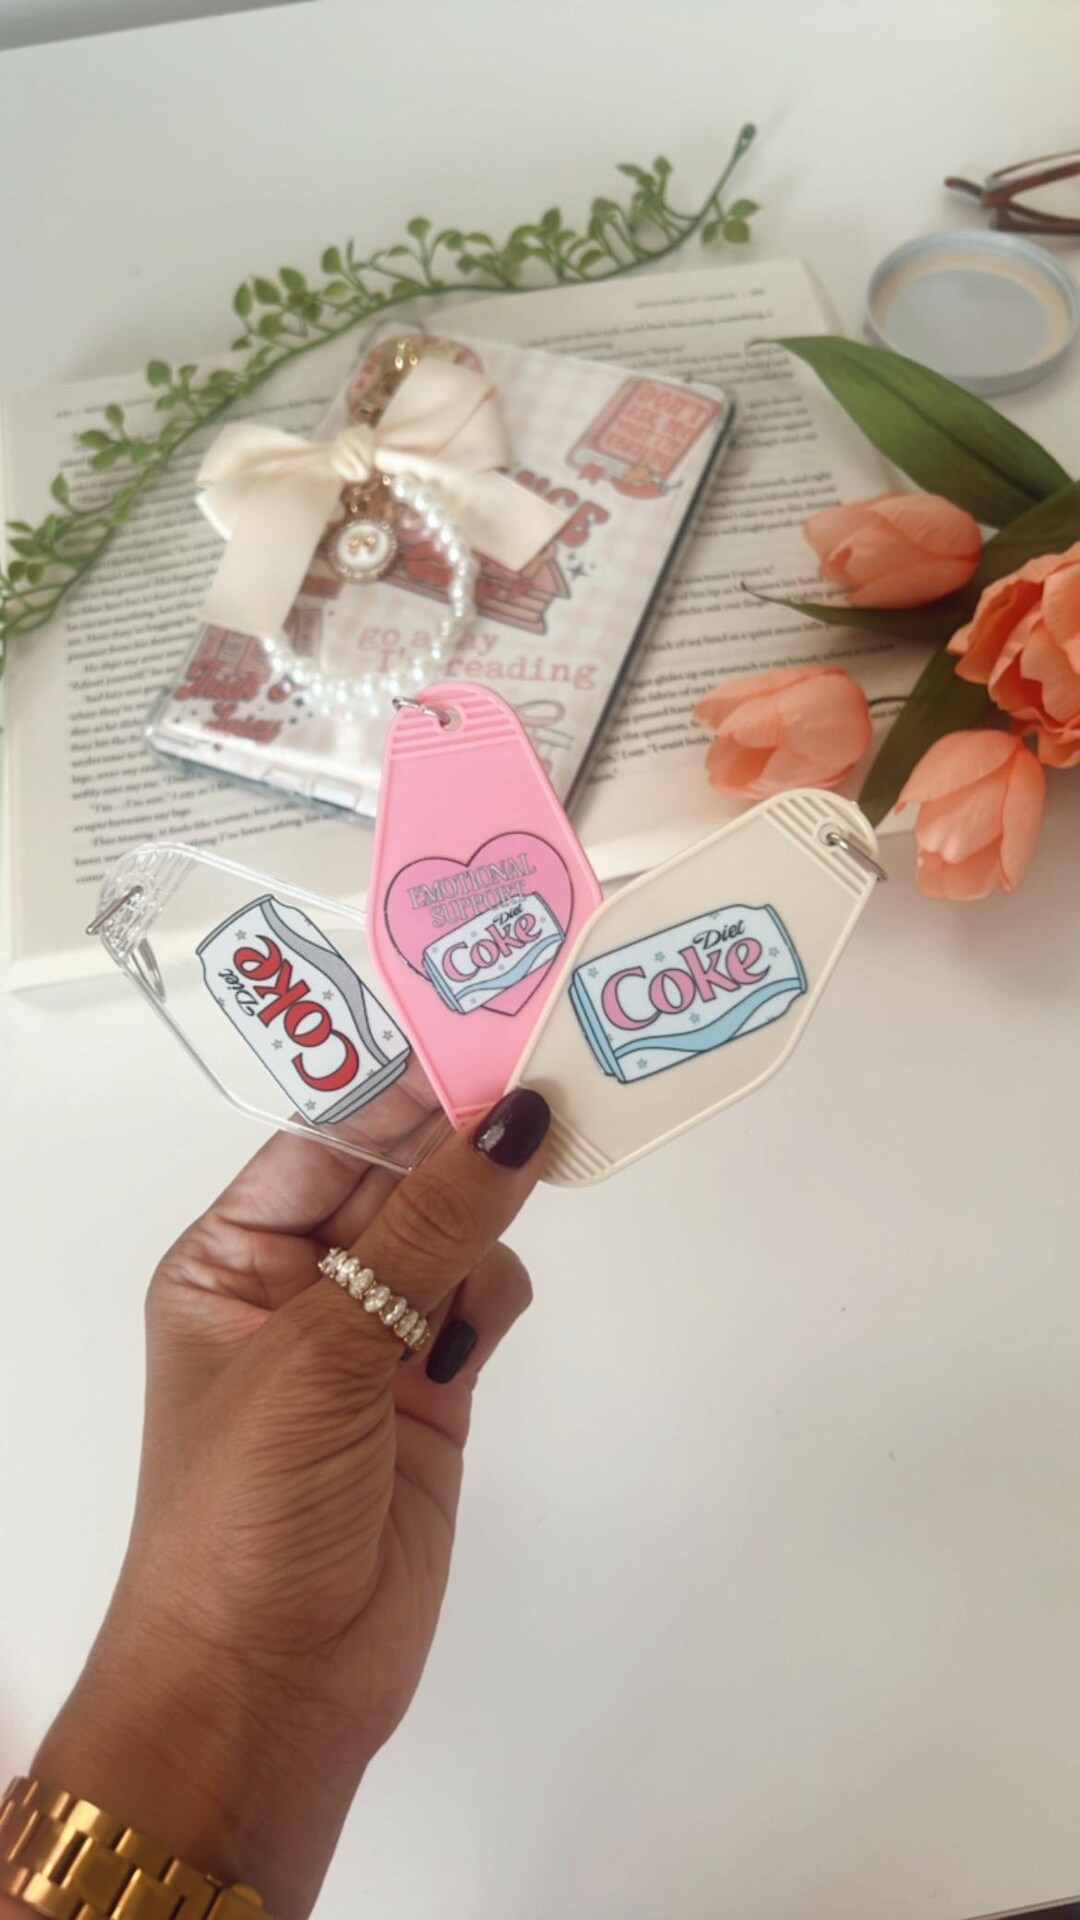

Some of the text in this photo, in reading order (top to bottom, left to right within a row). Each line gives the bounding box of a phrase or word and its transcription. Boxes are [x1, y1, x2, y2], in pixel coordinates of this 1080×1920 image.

[412, 629, 500, 654] aay
[444, 655, 597, 690] reading
[407, 853, 537, 910] EMOTIONAL
[429, 880, 528, 927] SUPPORT
[492, 904, 523, 925] Diet
[693, 919, 746, 949] Diet
[442, 913, 542, 983] Coke
[218, 969, 259, 1017] Diet
[601, 937, 771, 1031] Coke
[233, 934, 360, 1092] Coke
